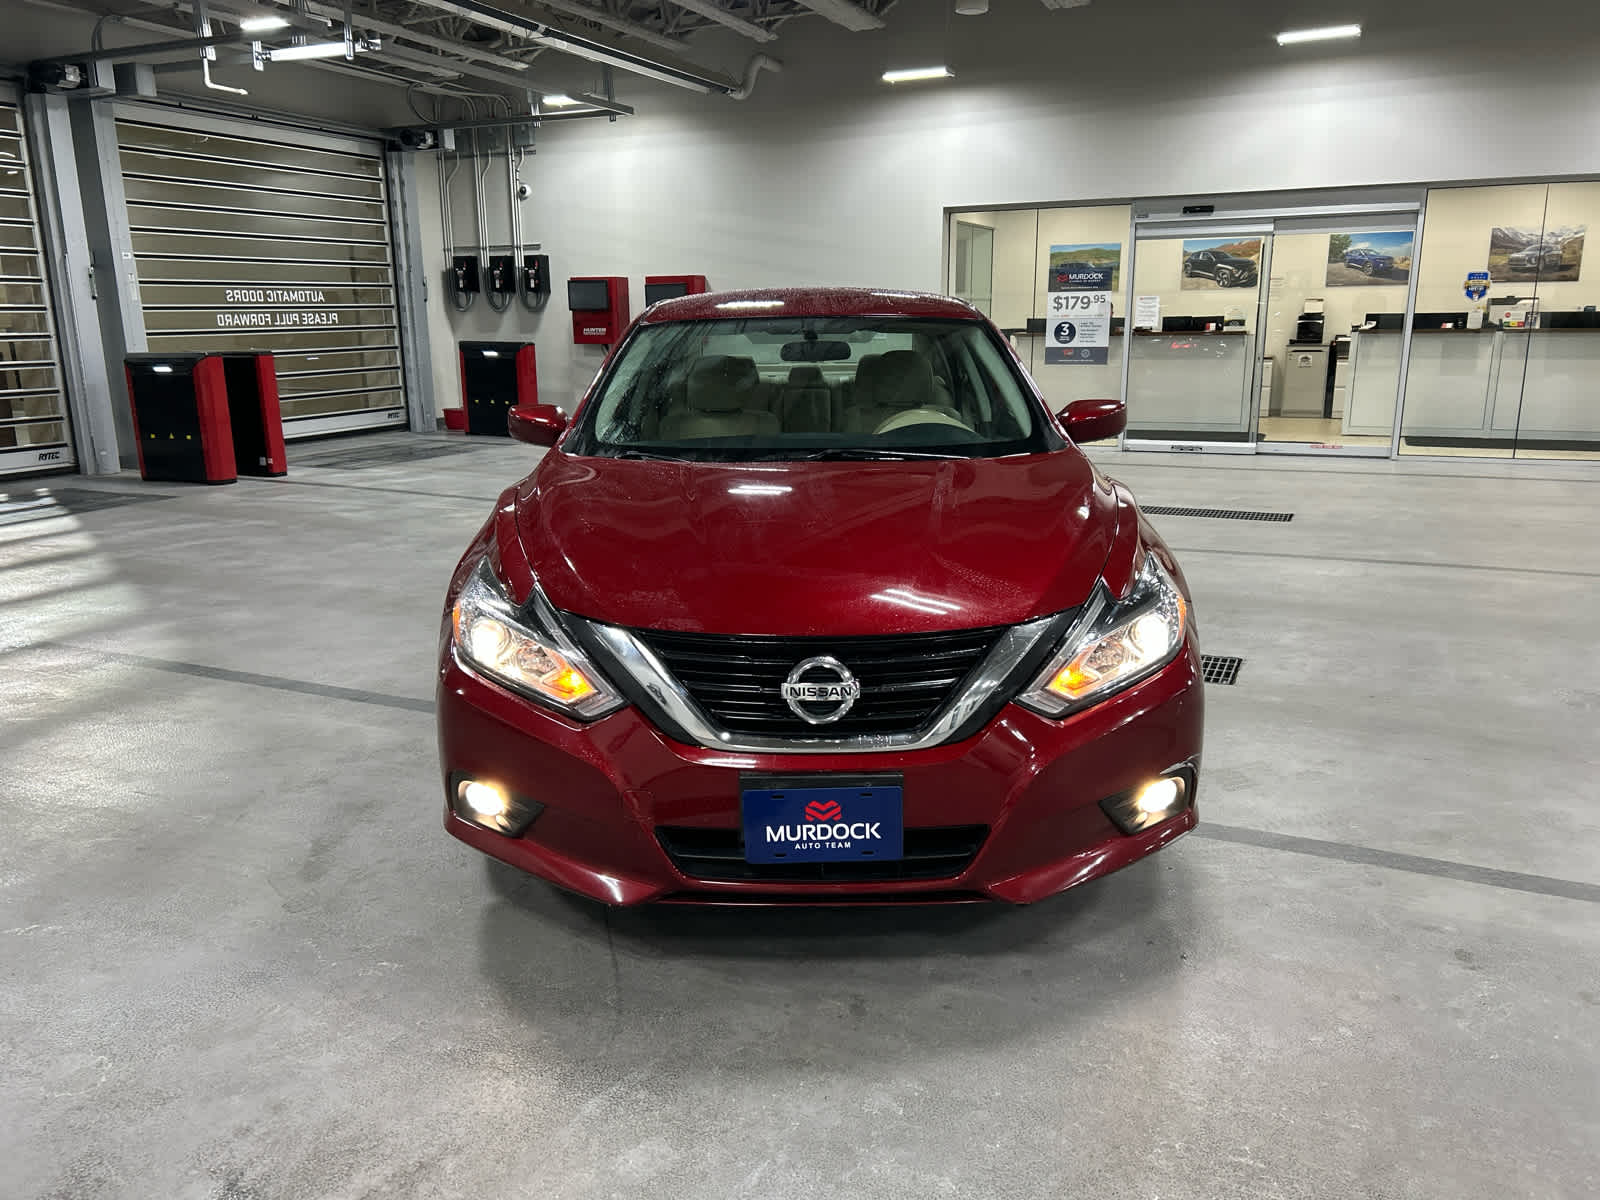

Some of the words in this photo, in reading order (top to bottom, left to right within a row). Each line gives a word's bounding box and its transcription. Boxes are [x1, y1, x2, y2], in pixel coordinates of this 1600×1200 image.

[1053, 294, 1106, 312] $179.95
[1060, 323, 1070, 336] 3
[38, 451, 60, 461] RYTEC
[789, 686, 852, 697] NISSAN
[765, 822, 882, 843] MURDOCK
[794, 842, 821, 850] AUTO
[824, 841, 851, 849] TEAM
